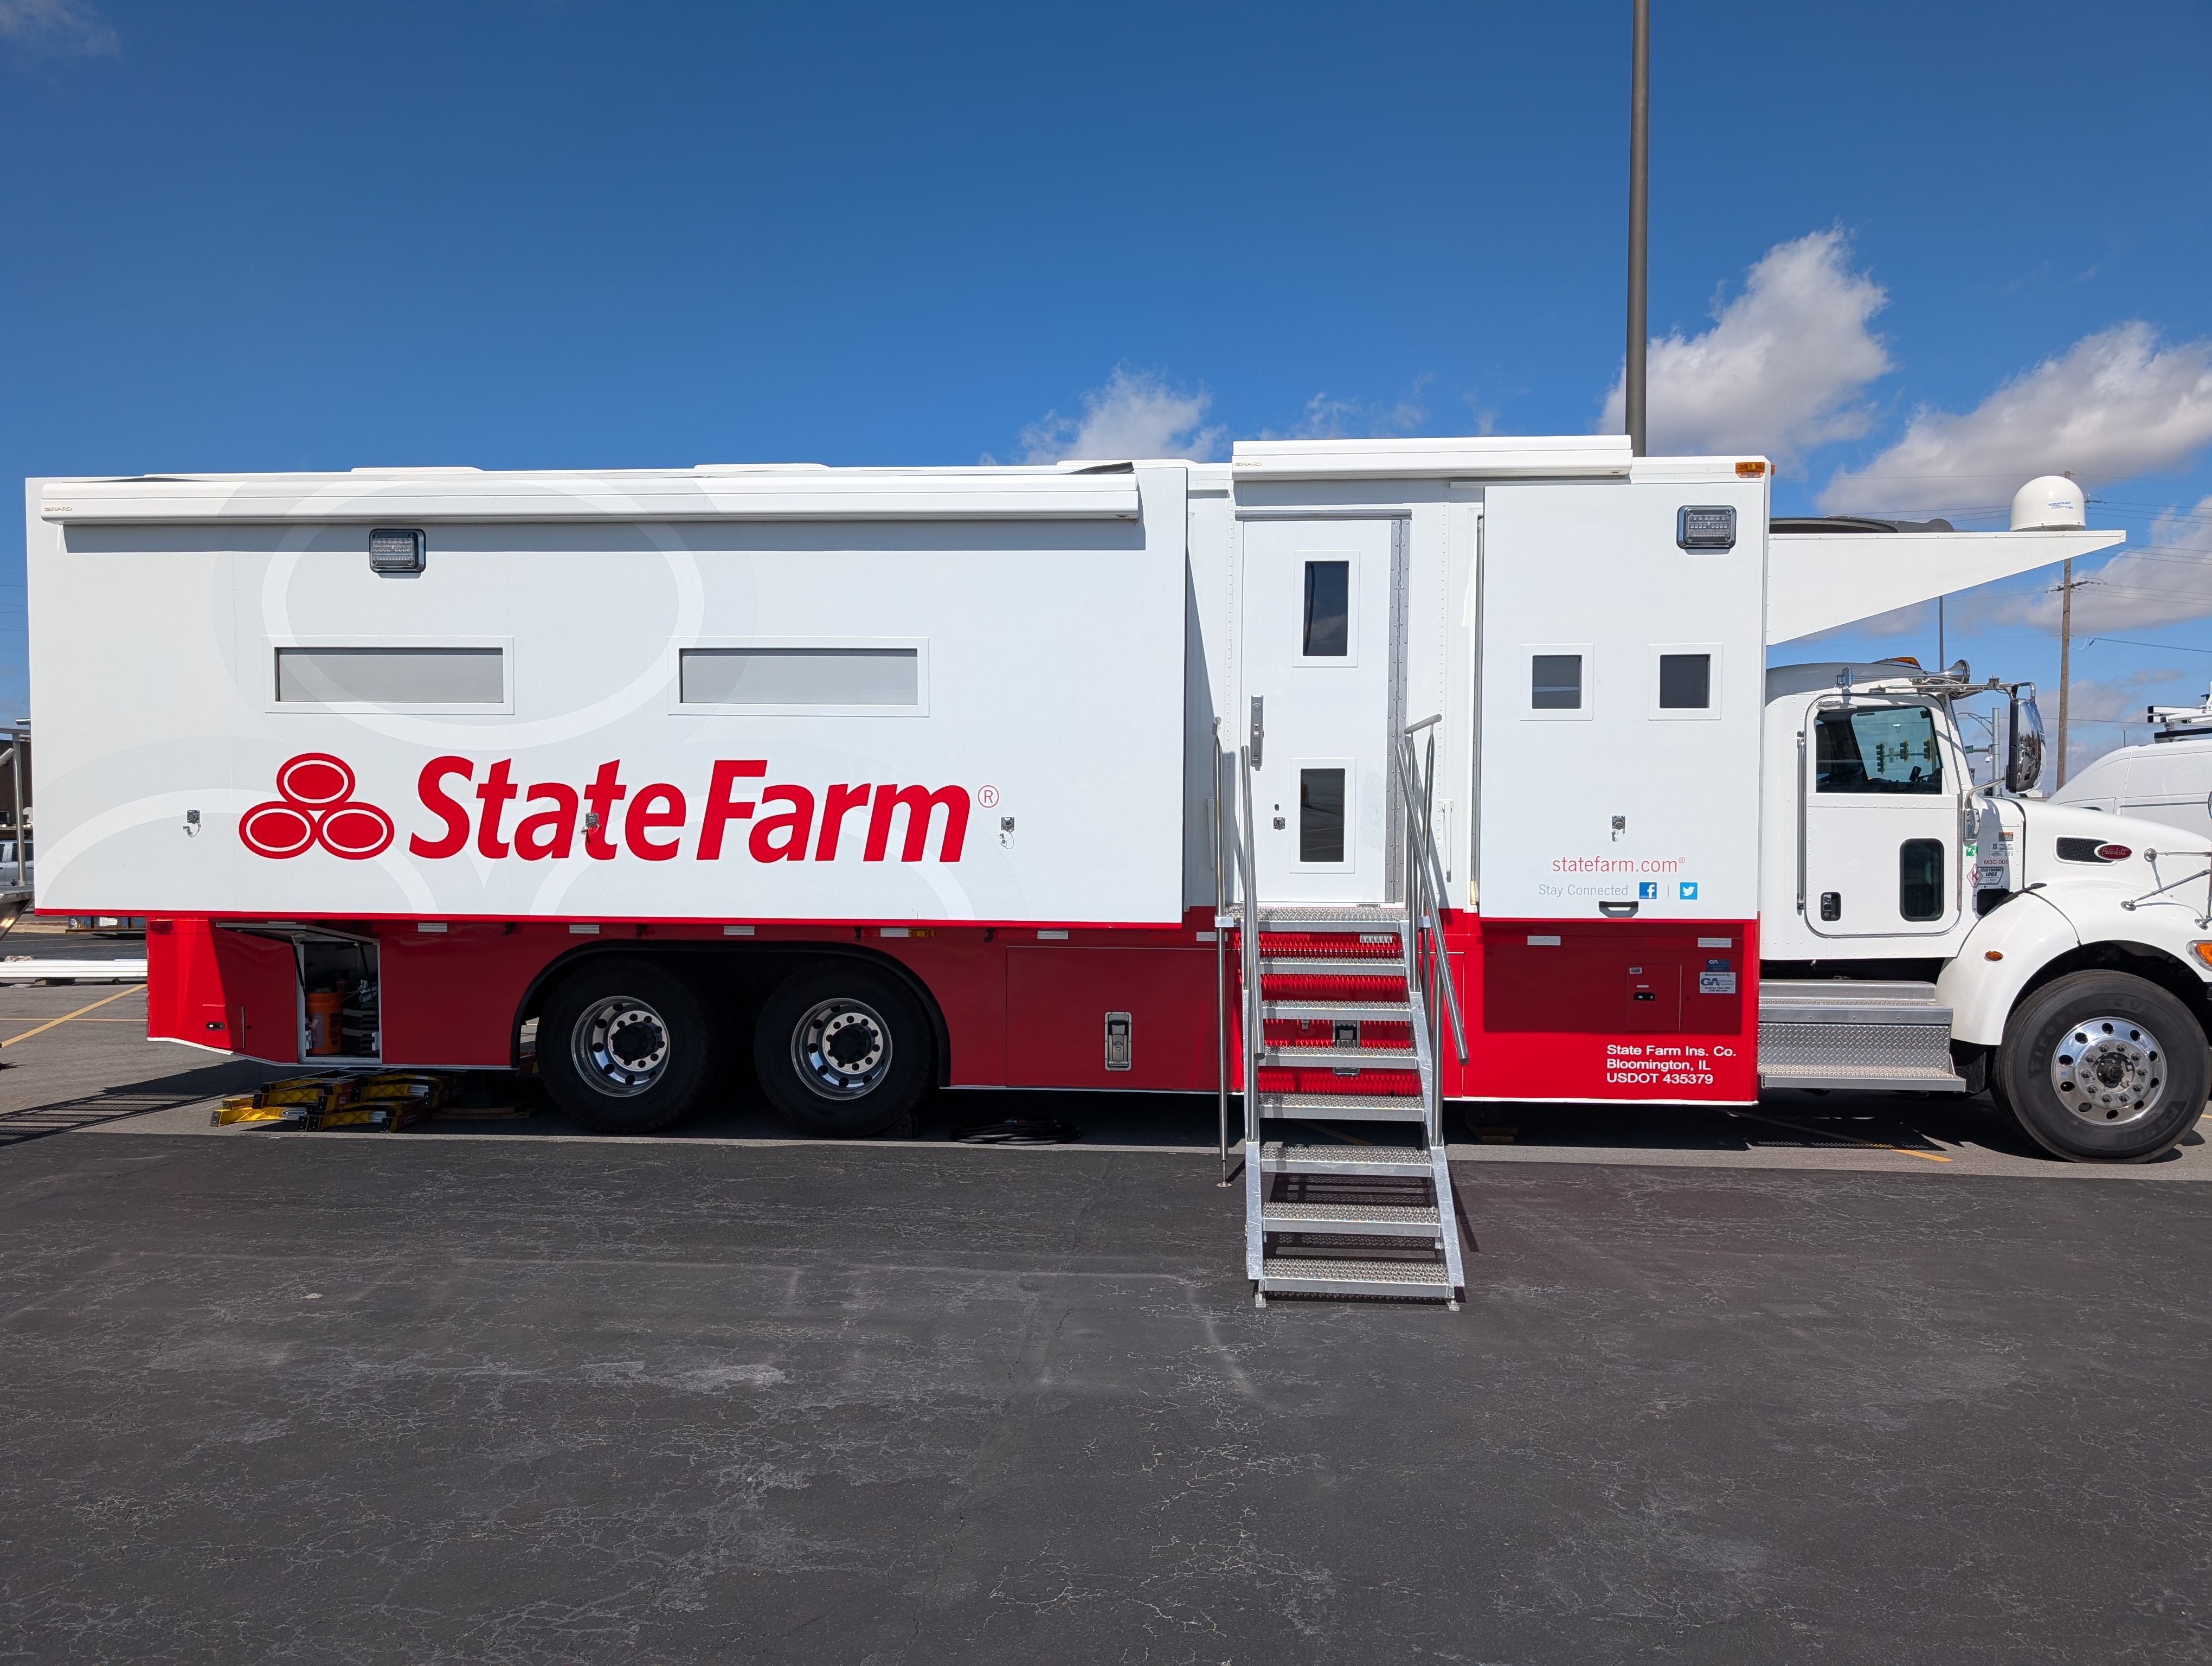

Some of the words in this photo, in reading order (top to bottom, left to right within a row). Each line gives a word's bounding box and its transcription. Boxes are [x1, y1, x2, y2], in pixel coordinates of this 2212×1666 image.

[409, 756, 686, 861] State
[2101, 847, 2130, 855] Peterbilt
[1539, 885, 1563, 897] Stay
[1568, 885, 1628, 895] Connected
[1607, 1045, 1642, 1055] State
[1647, 1046, 1681, 1055] Farm
[1686, 1046, 1708, 1056] Ins.
[1714, 1046, 1736, 1056] Co.
[1607, 1059, 1693, 1072] Bloomington,
[1699, 1060, 1711, 1070] IL
[1607, 1073, 1659, 1083] USDOT
[1663, 1074, 1713, 1084] 435379
